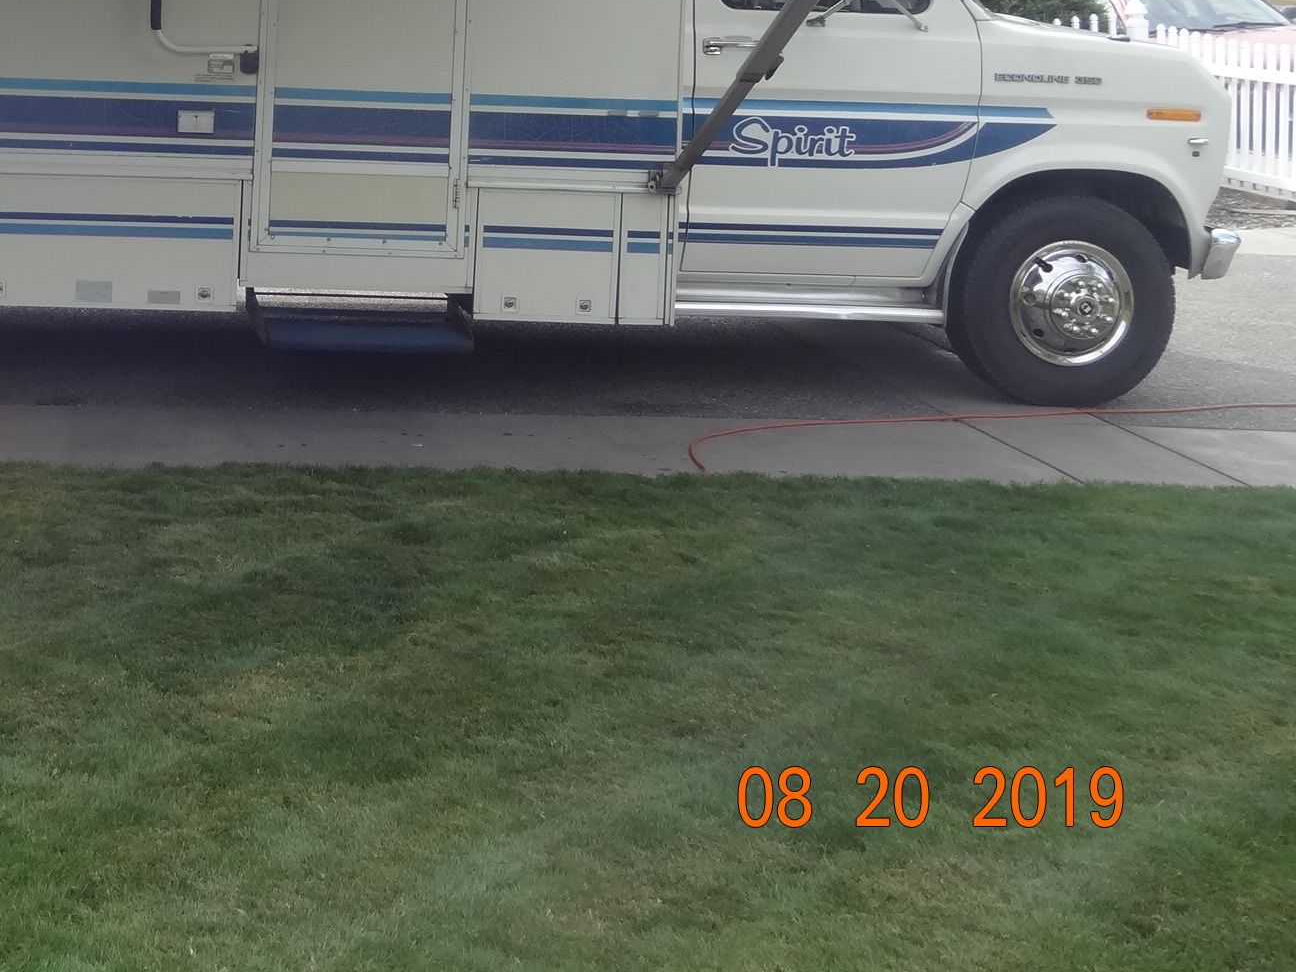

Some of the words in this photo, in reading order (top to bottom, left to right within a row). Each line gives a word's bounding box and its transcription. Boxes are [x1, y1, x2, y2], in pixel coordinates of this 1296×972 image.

[994, 72, 1070, 85] ECONOLINE
[1074, 75, 1103, 86] 350
[729, 116, 856, 168] Spirit
